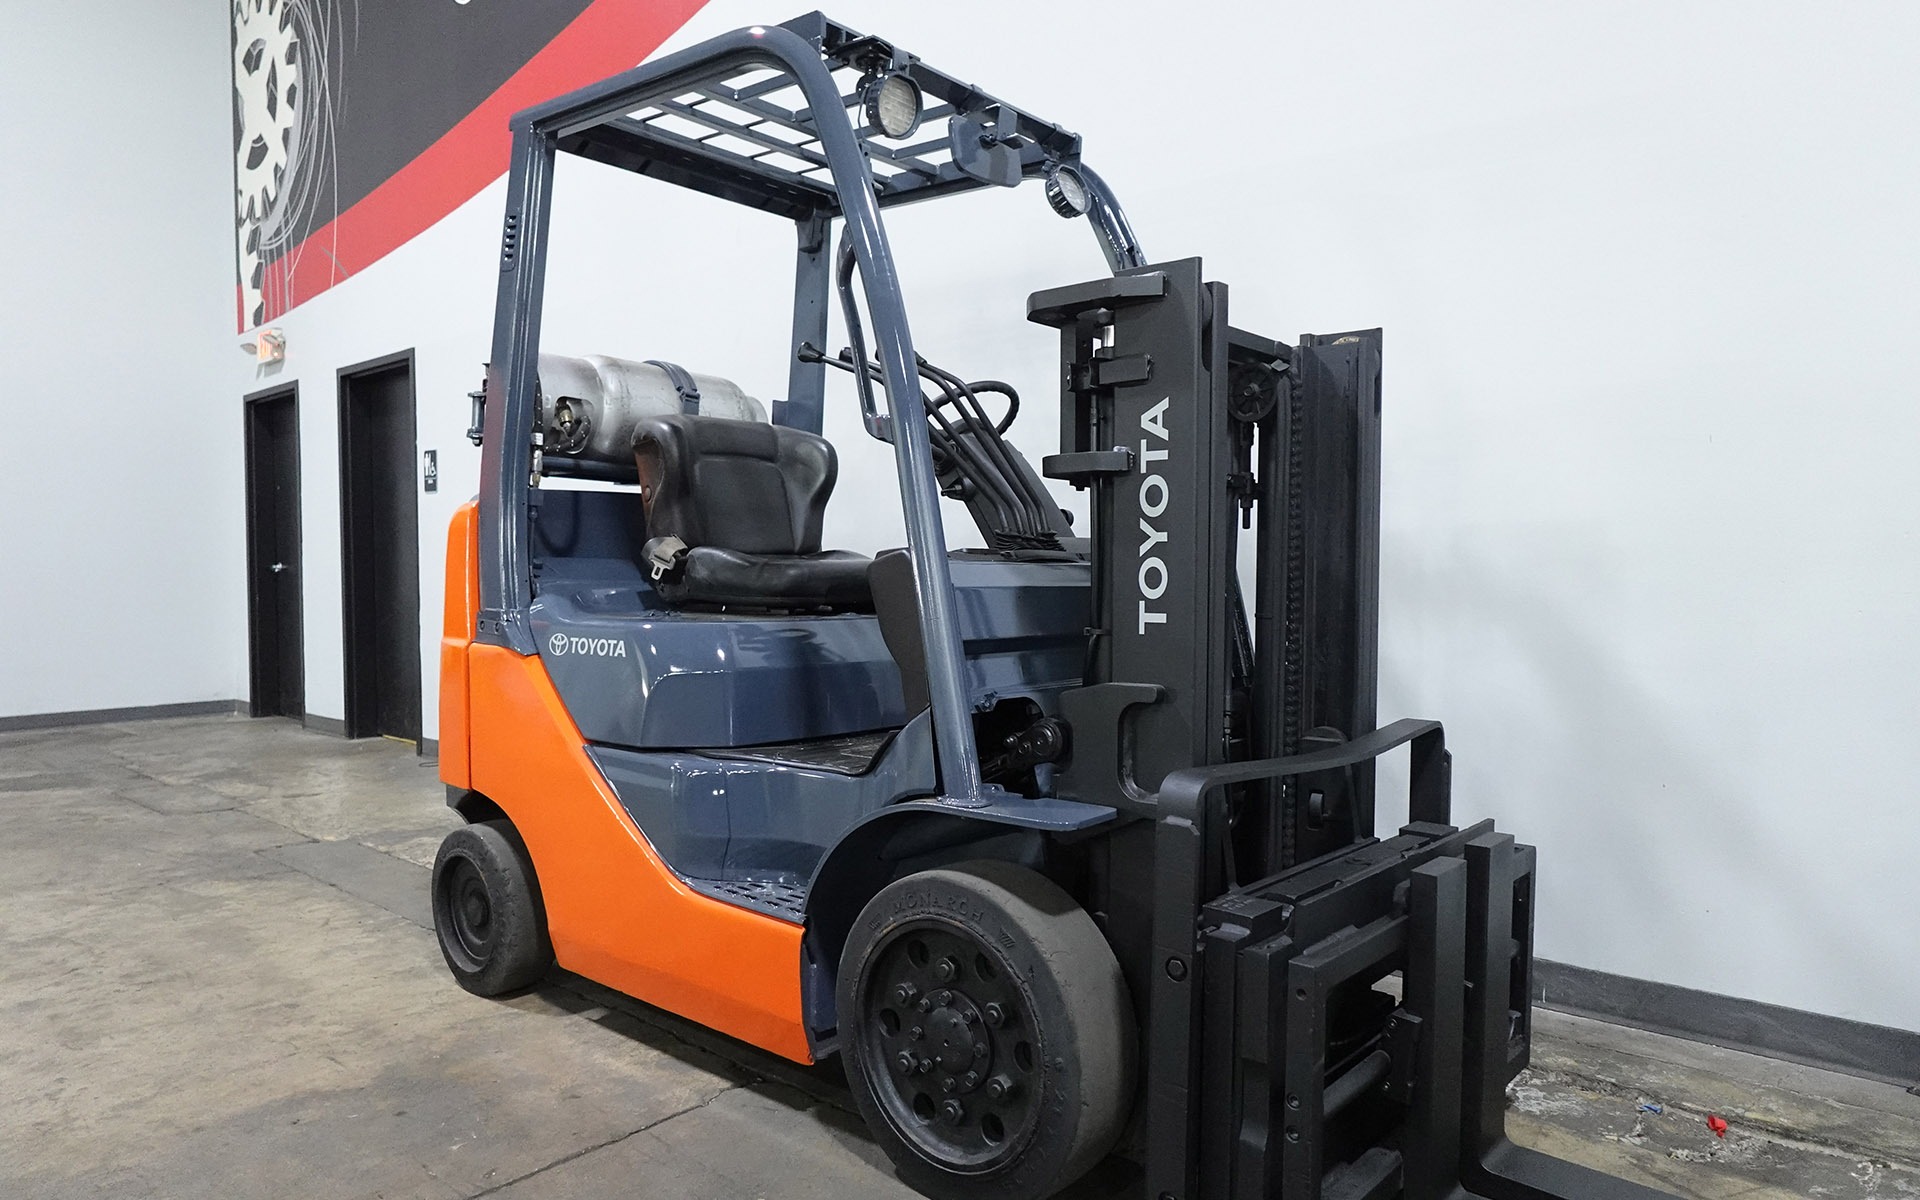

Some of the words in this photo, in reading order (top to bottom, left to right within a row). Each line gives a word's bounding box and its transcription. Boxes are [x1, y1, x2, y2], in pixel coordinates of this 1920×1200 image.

[1138, 397, 1170, 635] TOYOTA
[570, 637, 626, 658] TOYOTA
[894, 892, 983, 922] MONARCH
